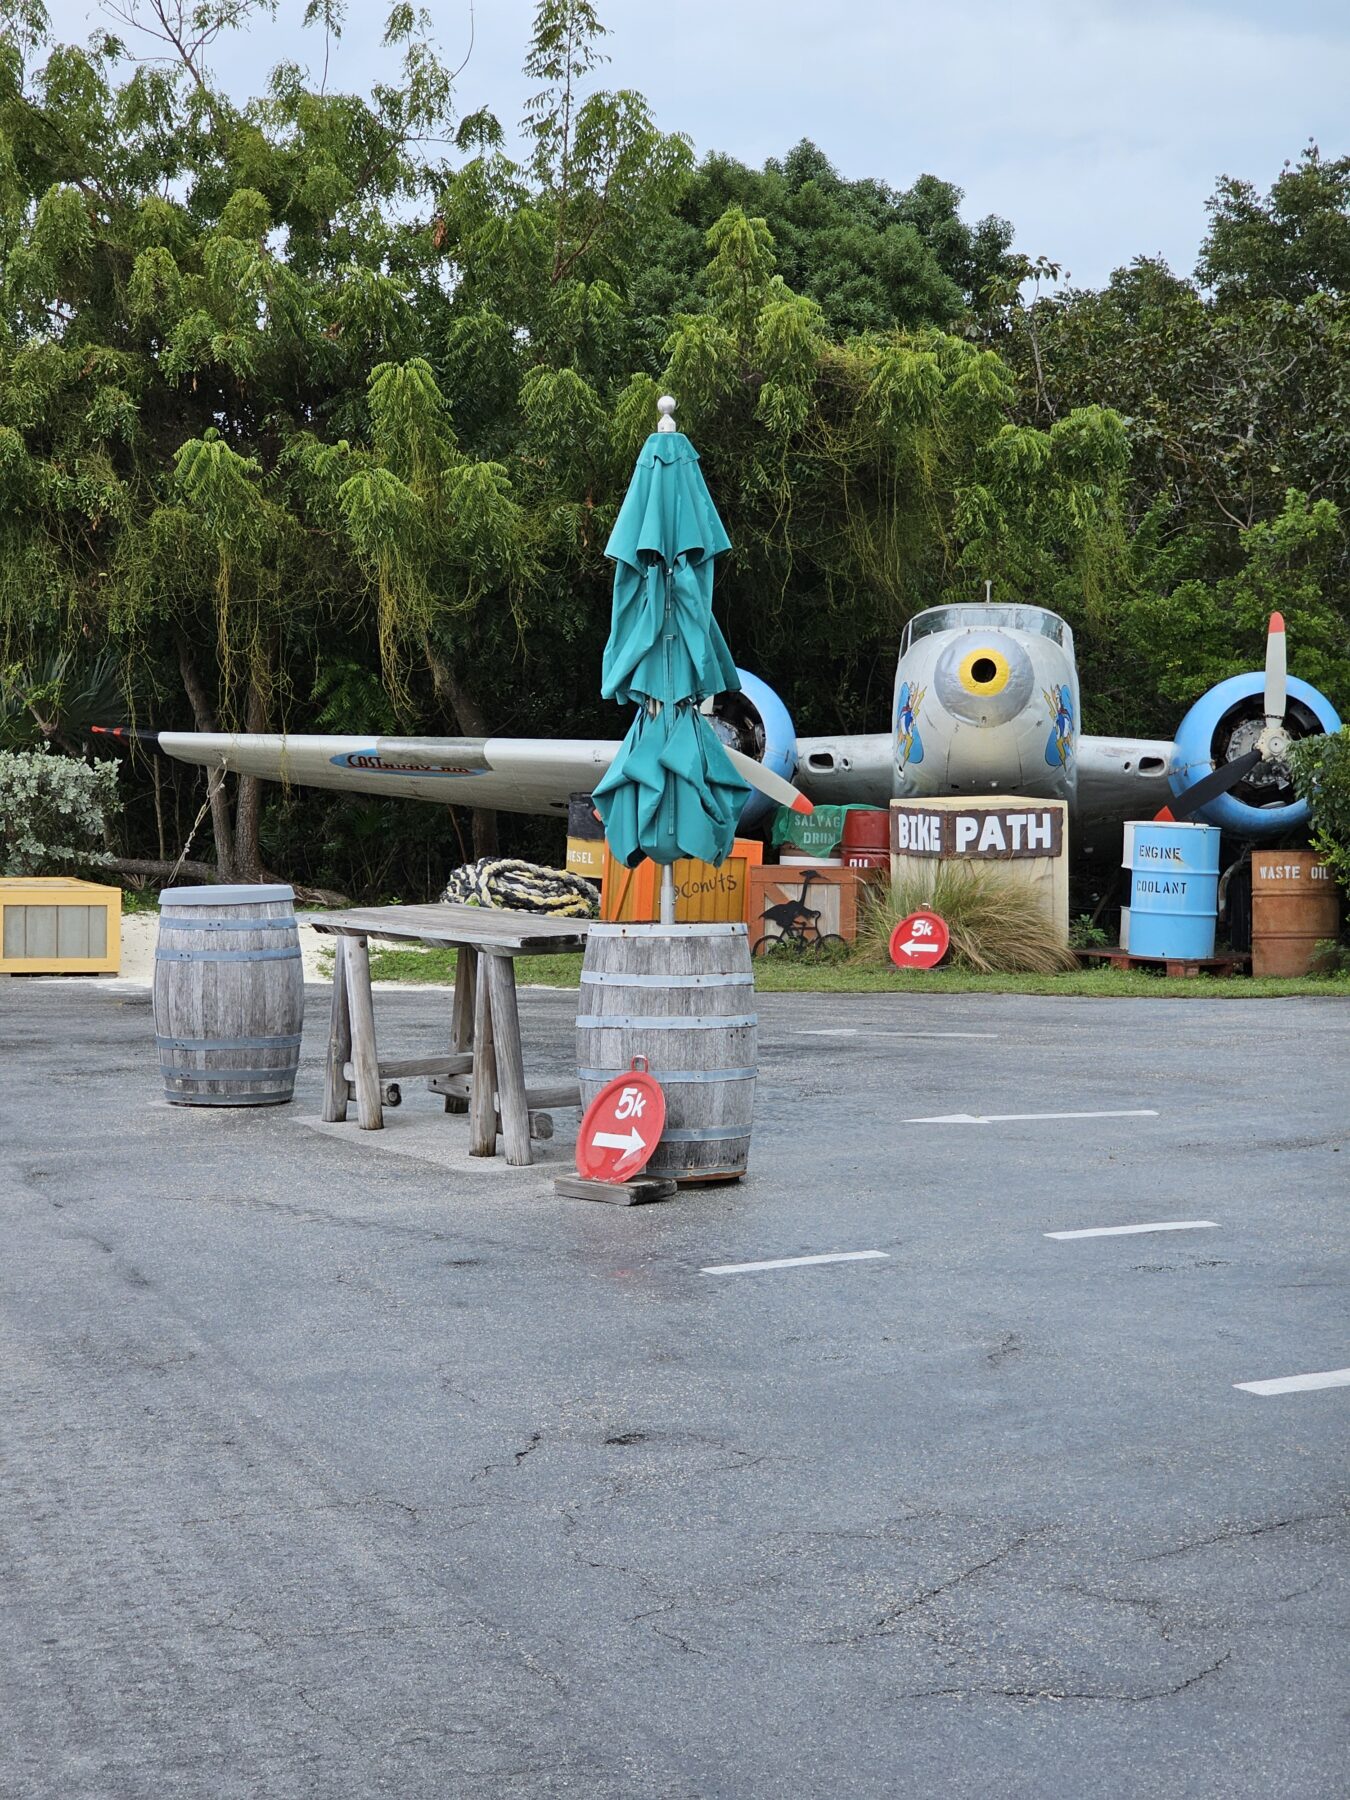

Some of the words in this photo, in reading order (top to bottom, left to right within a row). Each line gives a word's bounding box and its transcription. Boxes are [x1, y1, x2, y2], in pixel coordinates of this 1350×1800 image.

[803, 831, 836, 845] DRUM
[898, 813, 941, 852] BIKE
[955, 813, 1052, 853] PATH
[1139, 845, 1181, 860] ENGINE
[1259, 865, 1301, 880] WASTE
[1310, 866, 1329, 880] OIL
[1136, 879, 1187, 895] COOLANT
